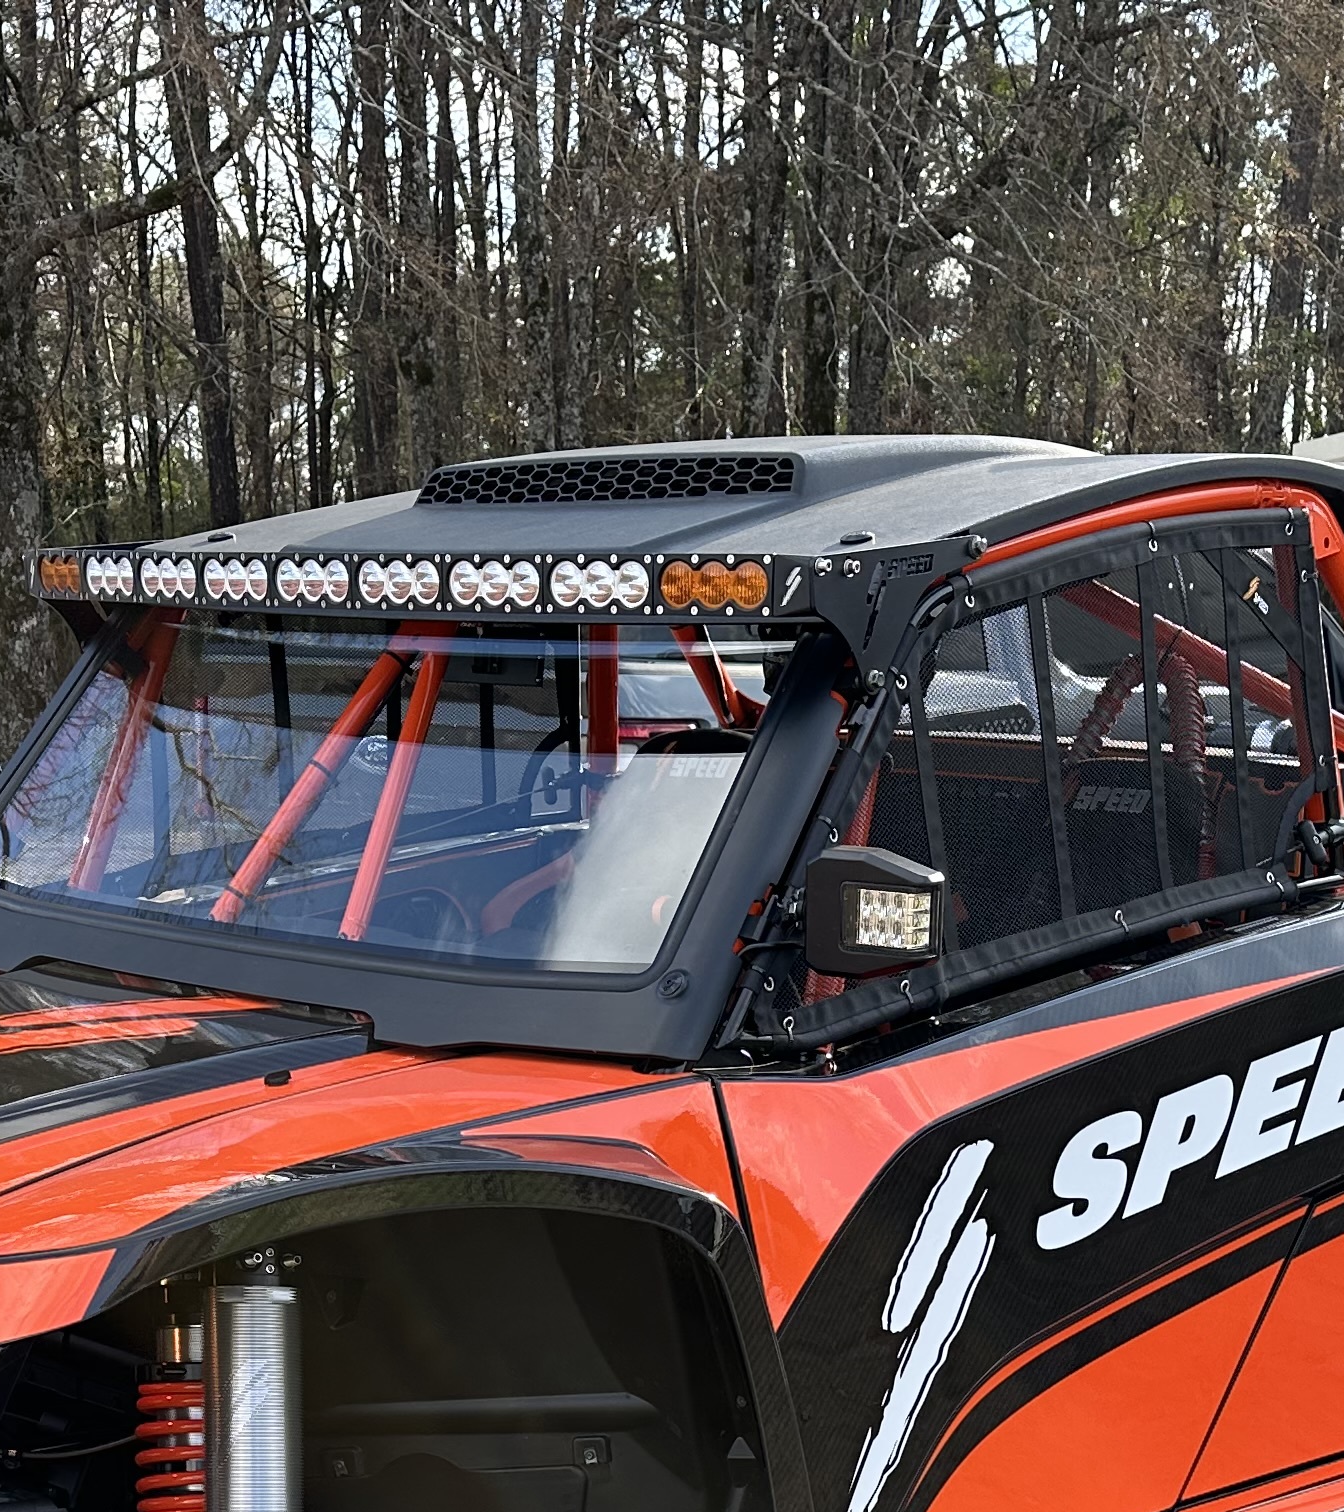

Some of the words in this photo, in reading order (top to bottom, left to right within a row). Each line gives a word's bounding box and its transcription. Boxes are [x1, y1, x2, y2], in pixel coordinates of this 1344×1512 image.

[887, 554, 934, 580] SPEED
[669, 757, 731, 778] SPEED
[1073, 786, 1152, 814] SPEED
